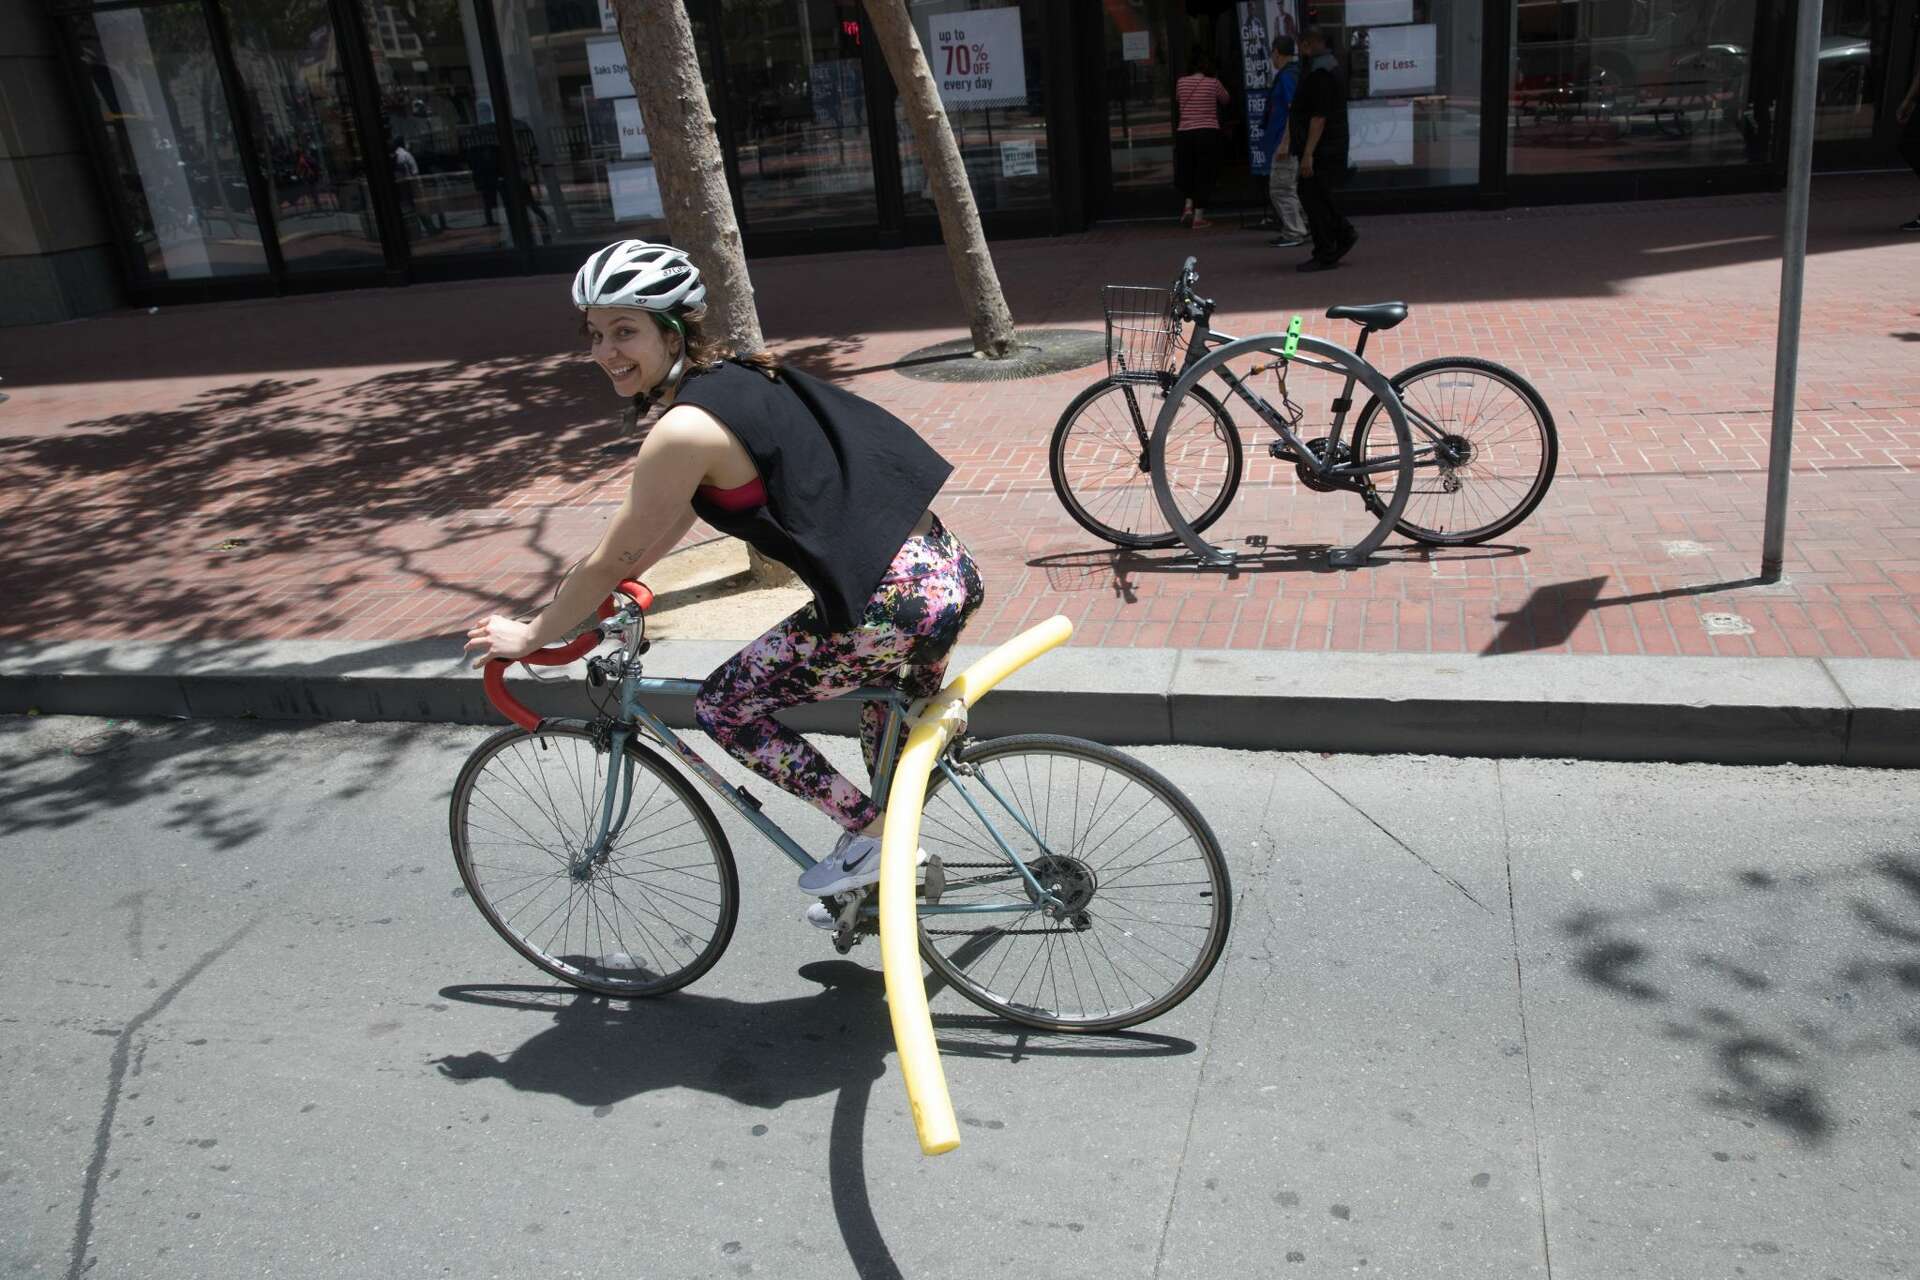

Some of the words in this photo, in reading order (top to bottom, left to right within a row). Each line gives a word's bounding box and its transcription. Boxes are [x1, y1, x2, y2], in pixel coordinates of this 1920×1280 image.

[939, 31, 951, 43] up
[954, 29, 965, 40] to
[594, 65, 611, 75] Saks
[973, 63, 990, 74] OFF
[1375, 60, 1390, 71] For
[1392, 60, 1418, 70] Less.
[944, 80, 971, 91] every
[975, 77, 992, 90] day
[623, 126, 634, 136] For
